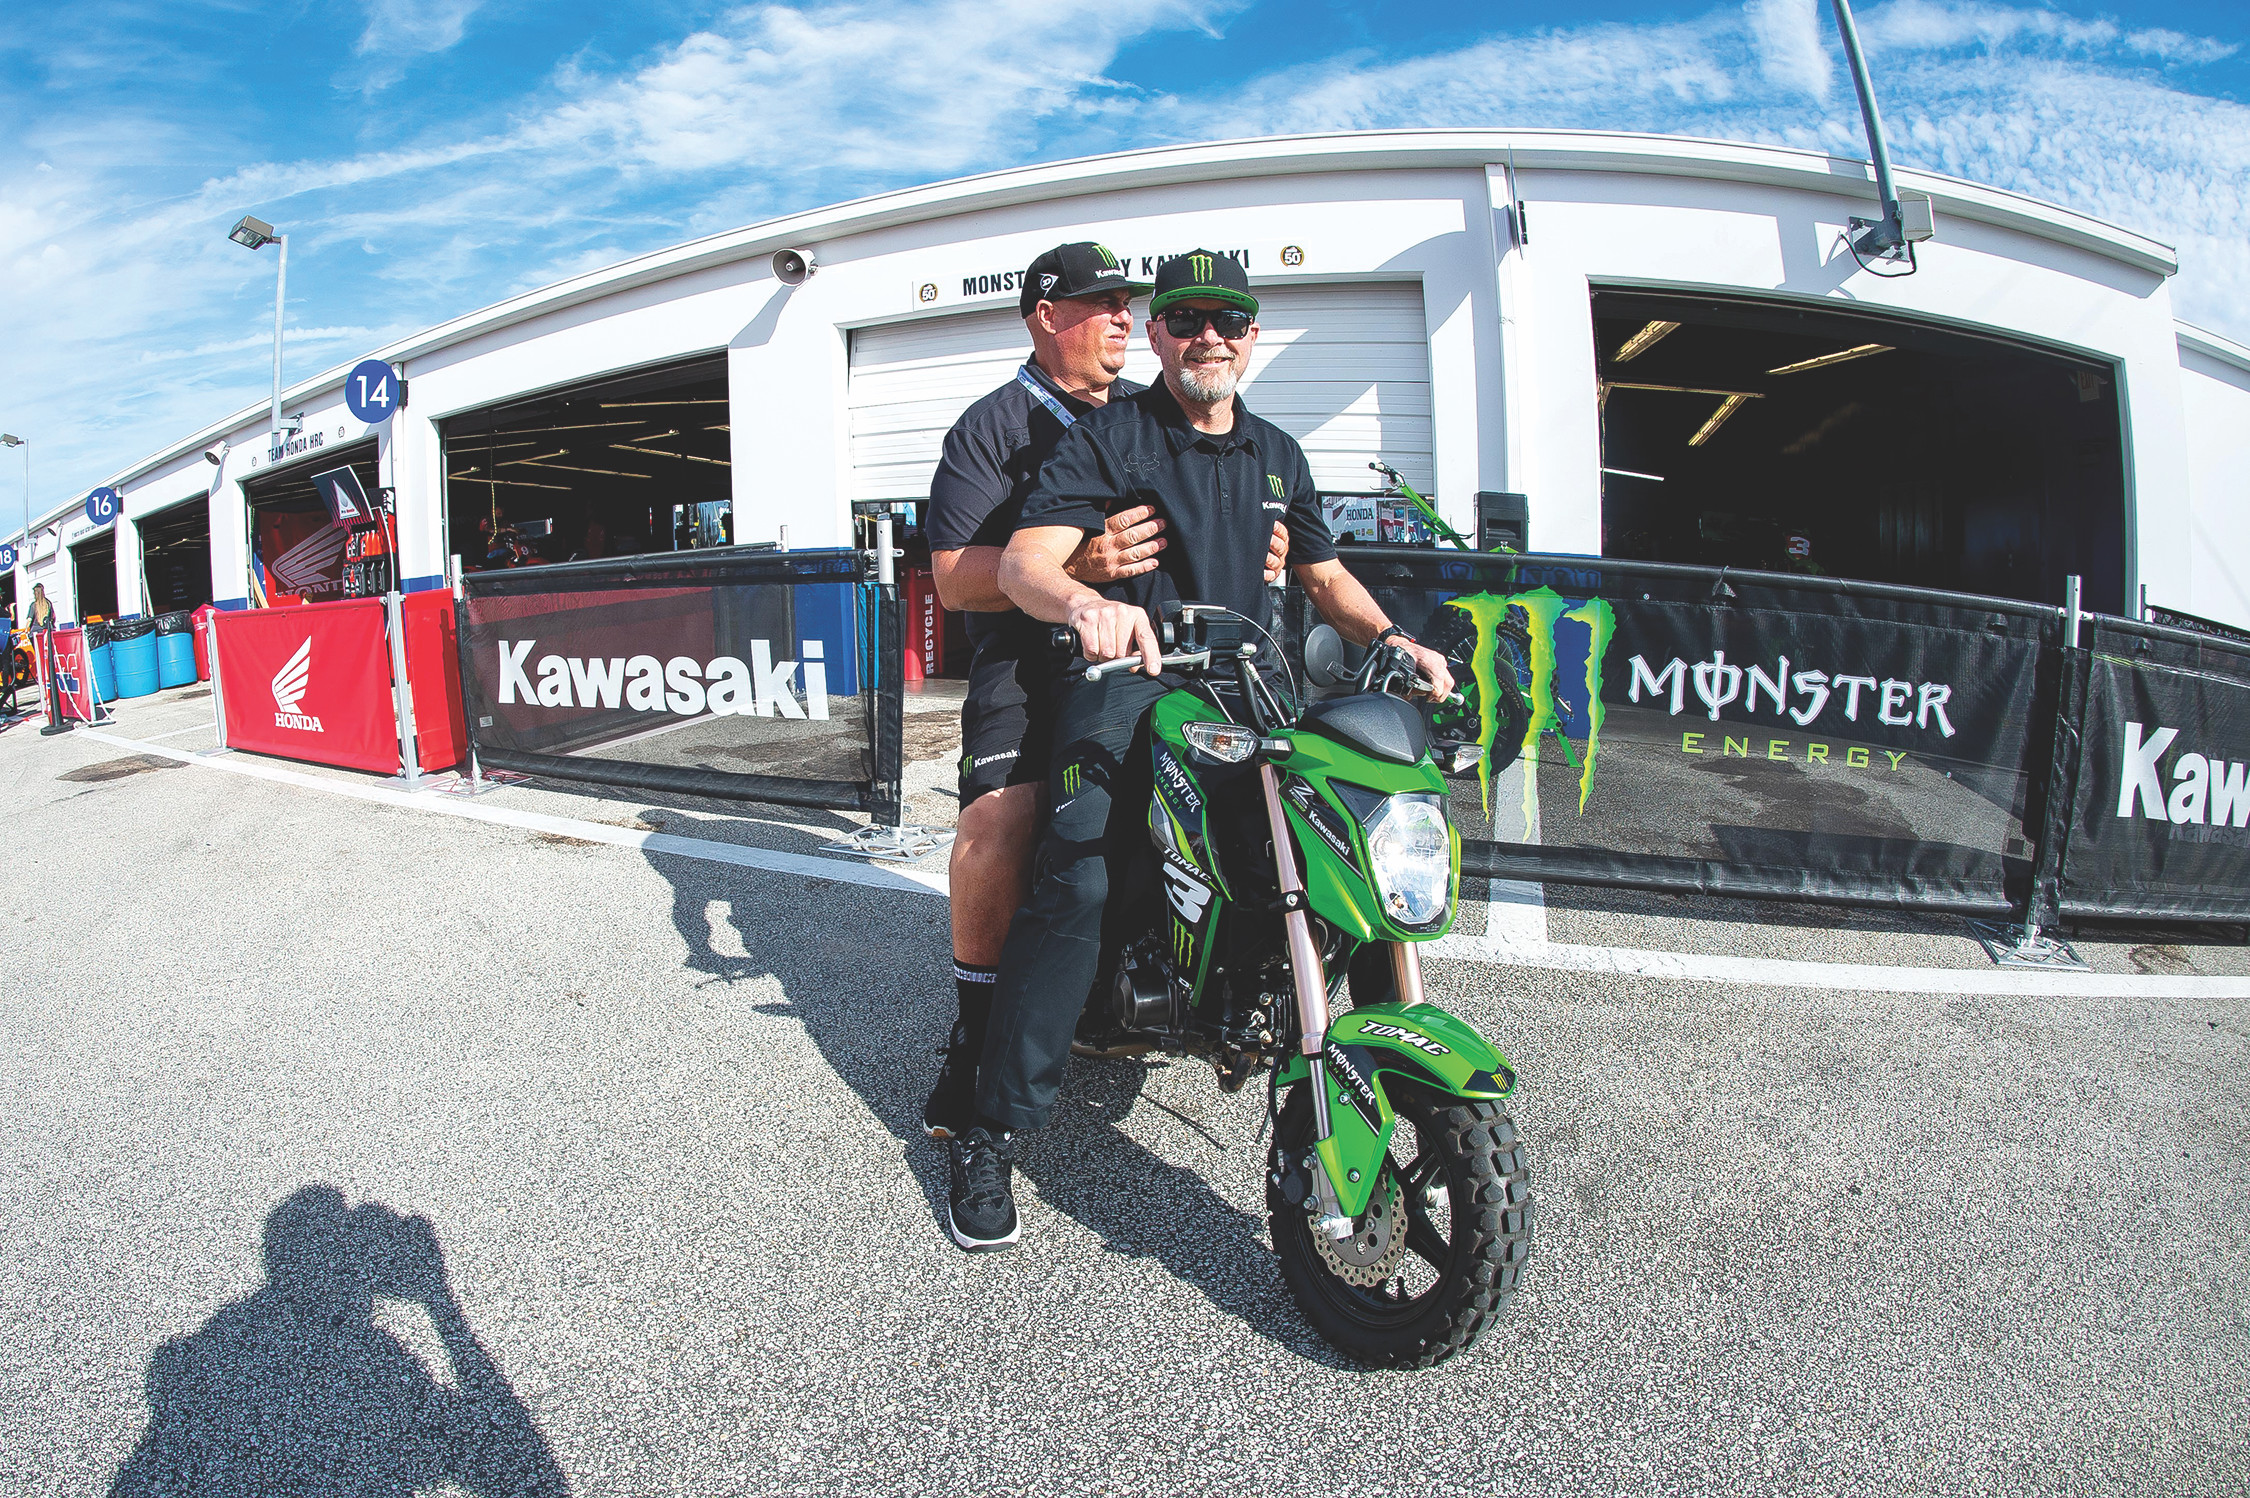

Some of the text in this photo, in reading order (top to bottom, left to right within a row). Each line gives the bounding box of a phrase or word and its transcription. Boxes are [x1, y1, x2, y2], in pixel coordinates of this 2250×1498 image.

[1284, 252, 1302, 265] 50
[921, 288, 937, 301] 50
[963, 270, 1026, 296] MONST
[356, 375, 390, 408] 14
[268, 444, 284, 462] TEAM
[286, 437, 308, 456] HONDA
[310, 431, 324, 449] HRC
[92, 494, 113, 517] 16
[1346, 507, 1375, 521] HONDA
[0, 549, 12, 566] 18
[1789, 536, 1810, 556] 3
[924, 593, 935, 676] RECYCLE
[498, 639, 831, 721] Kawasaki
[1628, 650, 1956, 738] MONSTER
[274, 712, 325, 733] HONDA
[974, 748, 1021, 768] Kawasaki
[1681, 731, 1907, 772] ENERGY
[1159, 751, 1202, 813] MONSTER
[2116, 721, 2250, 829] Kaw
[1308, 810, 1351, 856] Kawasaki
[1163, 845, 1212, 882] TOMAC
[1162, 861, 1212, 924] 3
[1358, 1020, 1451, 1056] TOMAC
[1327, 1043, 1376, 1106] MONSTER
